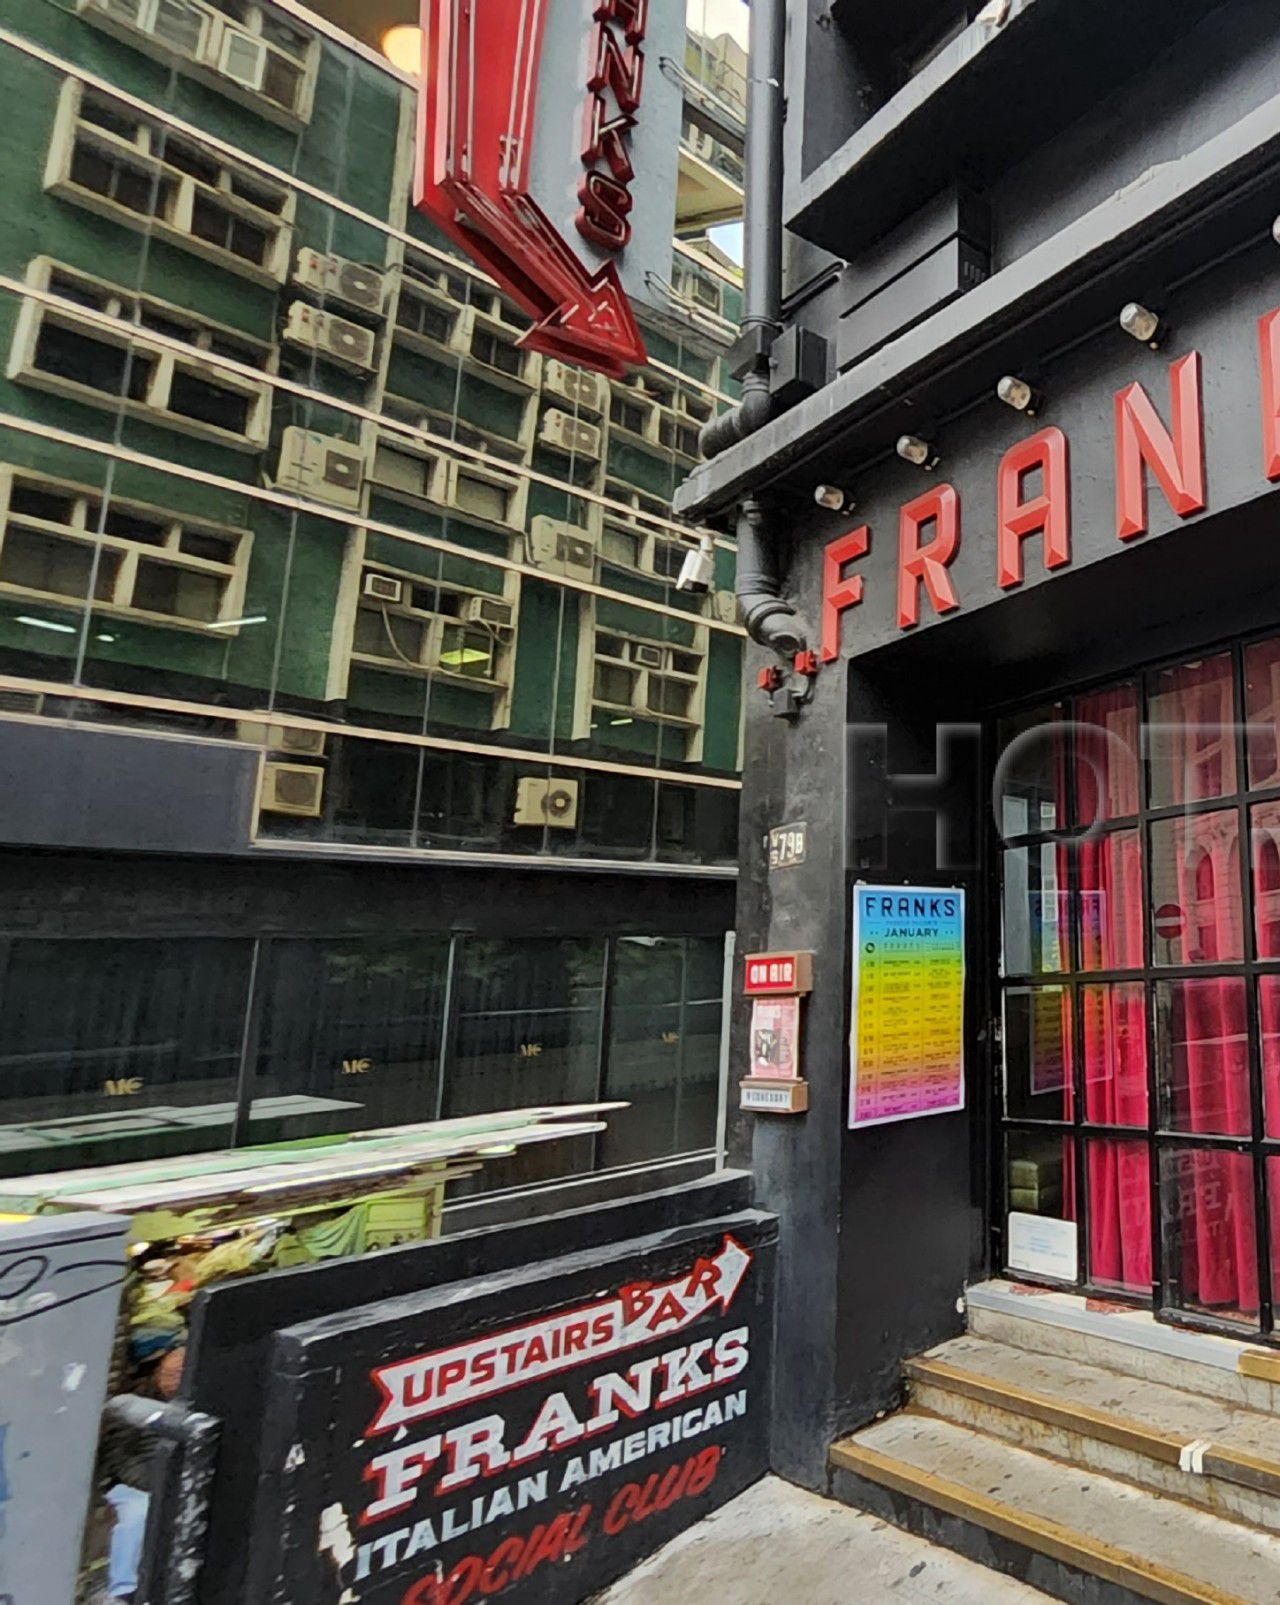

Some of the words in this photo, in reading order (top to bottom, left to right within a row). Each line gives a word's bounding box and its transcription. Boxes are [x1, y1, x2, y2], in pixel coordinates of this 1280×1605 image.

[865, 896, 955, 918] FRANKS
[884, 927, 939, 938] JANUARY
[750, 965, 768, 985] ON
[769, 962, 793, 983] AIR
[401, 1312, 615, 1408] UPSTAIRS
[617, 1257, 723, 1332] BAR
[359, 1327, 749, 1525] FRANKS
[353, 1470, 549, 1583] ITALIAN
[557, 1389, 748, 1495] AMERICAN
[603, 1444, 722, 1537] CLUB
